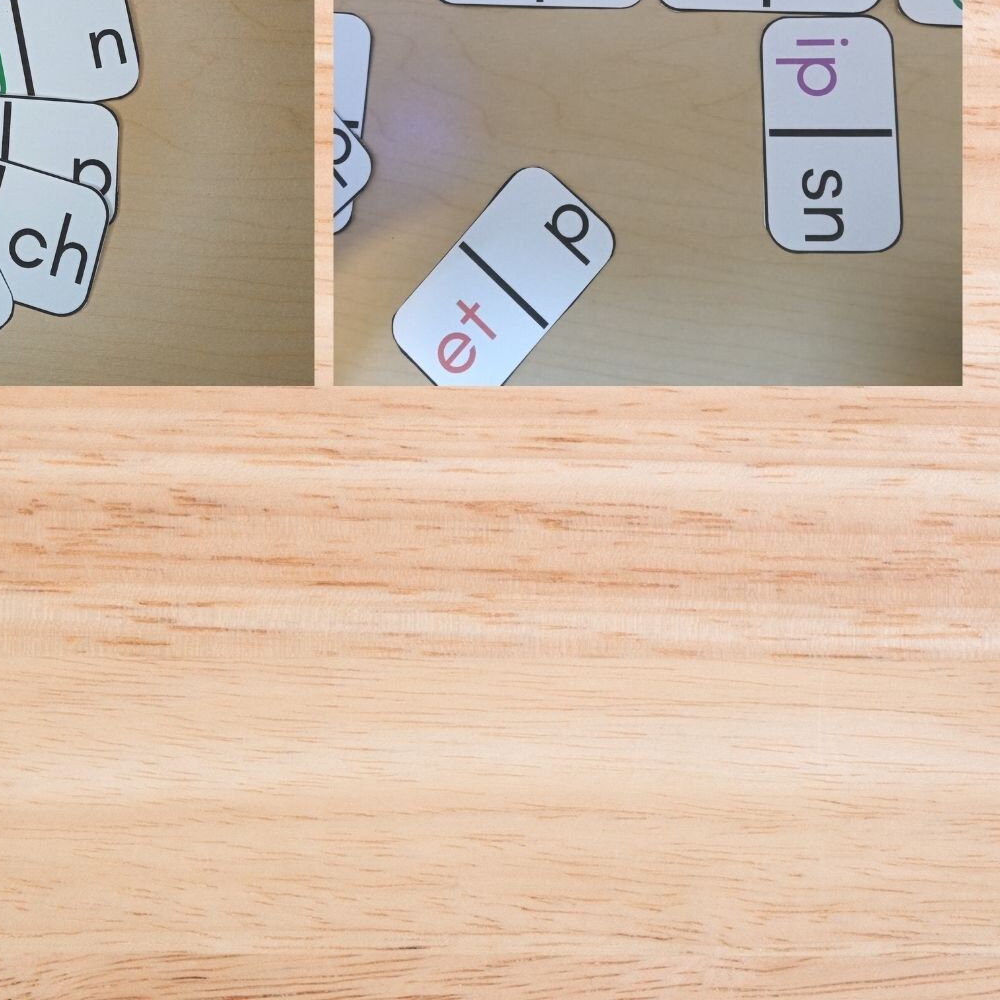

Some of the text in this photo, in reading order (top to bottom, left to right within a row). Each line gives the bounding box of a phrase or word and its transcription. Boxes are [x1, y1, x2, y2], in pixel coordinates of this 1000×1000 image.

[88, 28, 127, 69] n
[775, 38, 849, 242] ip sn
[8, 212, 88, 285] ch
[437, 203, 590, 374] et p
